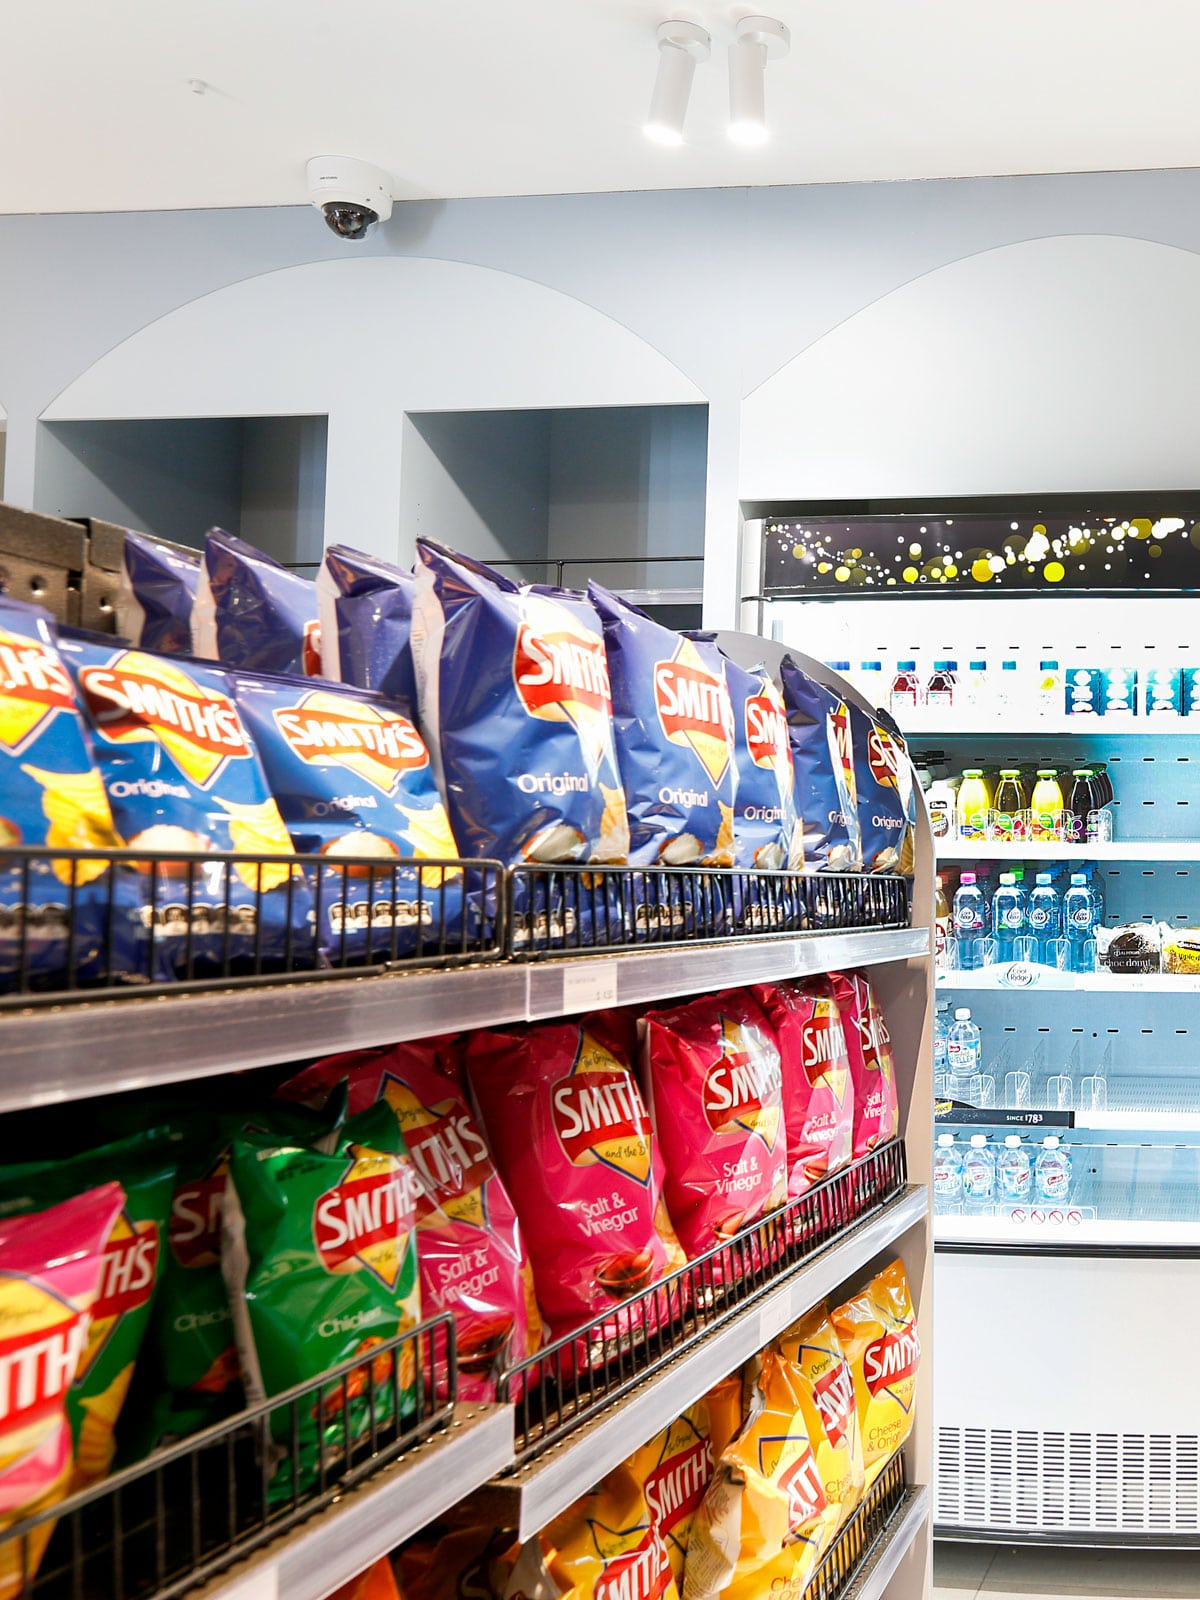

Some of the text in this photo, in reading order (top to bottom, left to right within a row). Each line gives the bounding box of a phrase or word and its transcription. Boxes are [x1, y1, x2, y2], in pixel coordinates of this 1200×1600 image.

[85, 671, 242, 746] SMITH'S
[277, 714, 425, 758] SMITH'S
[517, 772, 588, 796] Original
[313, 795, 378, 816] Original
[659, 787, 708, 808] Original
[744, 806, 787, 820] Origin
[872, 815, 903, 829] Original
[1103, 958, 1151, 967] choc donut
[811, 1112, 828, 1127] Salt
[1025, 1114, 1043, 1123] 1783
[723, 1157, 758, 1177] Salt &
[716, 1173, 763, 1194] Vinegar
[581, 1192, 626, 1219] Salt &
[578, 1206, 639, 1238] Vinegar
[438, 1248, 488, 1283] Salt &
[429, 1265, 500, 1307] Vinegar
[869, 1420, 901, 1440] Cheese
[867, 1442, 875, 1452] &
[645, 1439, 716, 1527] SMITH'S
